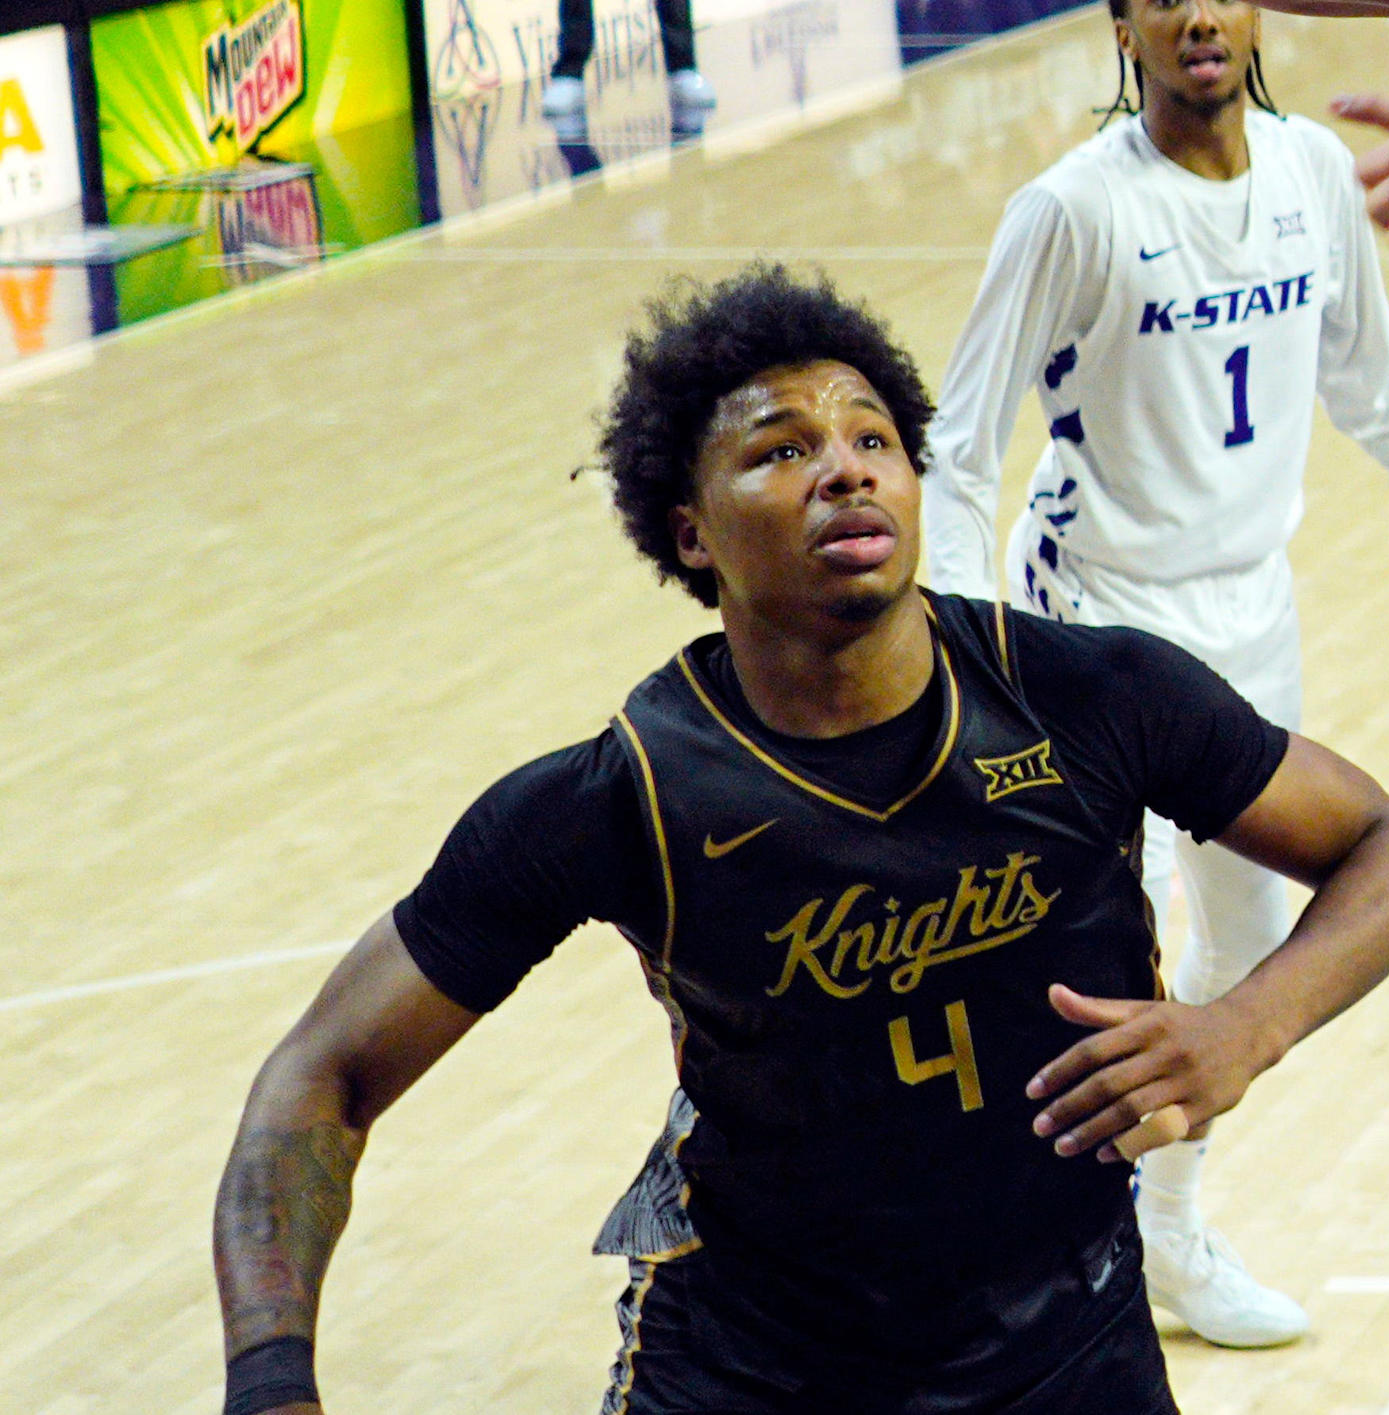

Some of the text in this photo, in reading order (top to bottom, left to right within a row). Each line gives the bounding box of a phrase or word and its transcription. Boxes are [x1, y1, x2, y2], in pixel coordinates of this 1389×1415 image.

[1138, 270, 1315, 334] K-STATE
[1223, 344, 1255, 449] 1
[765, 849, 1062, 1000] Knights
[887, 999, 984, 1113] 4
